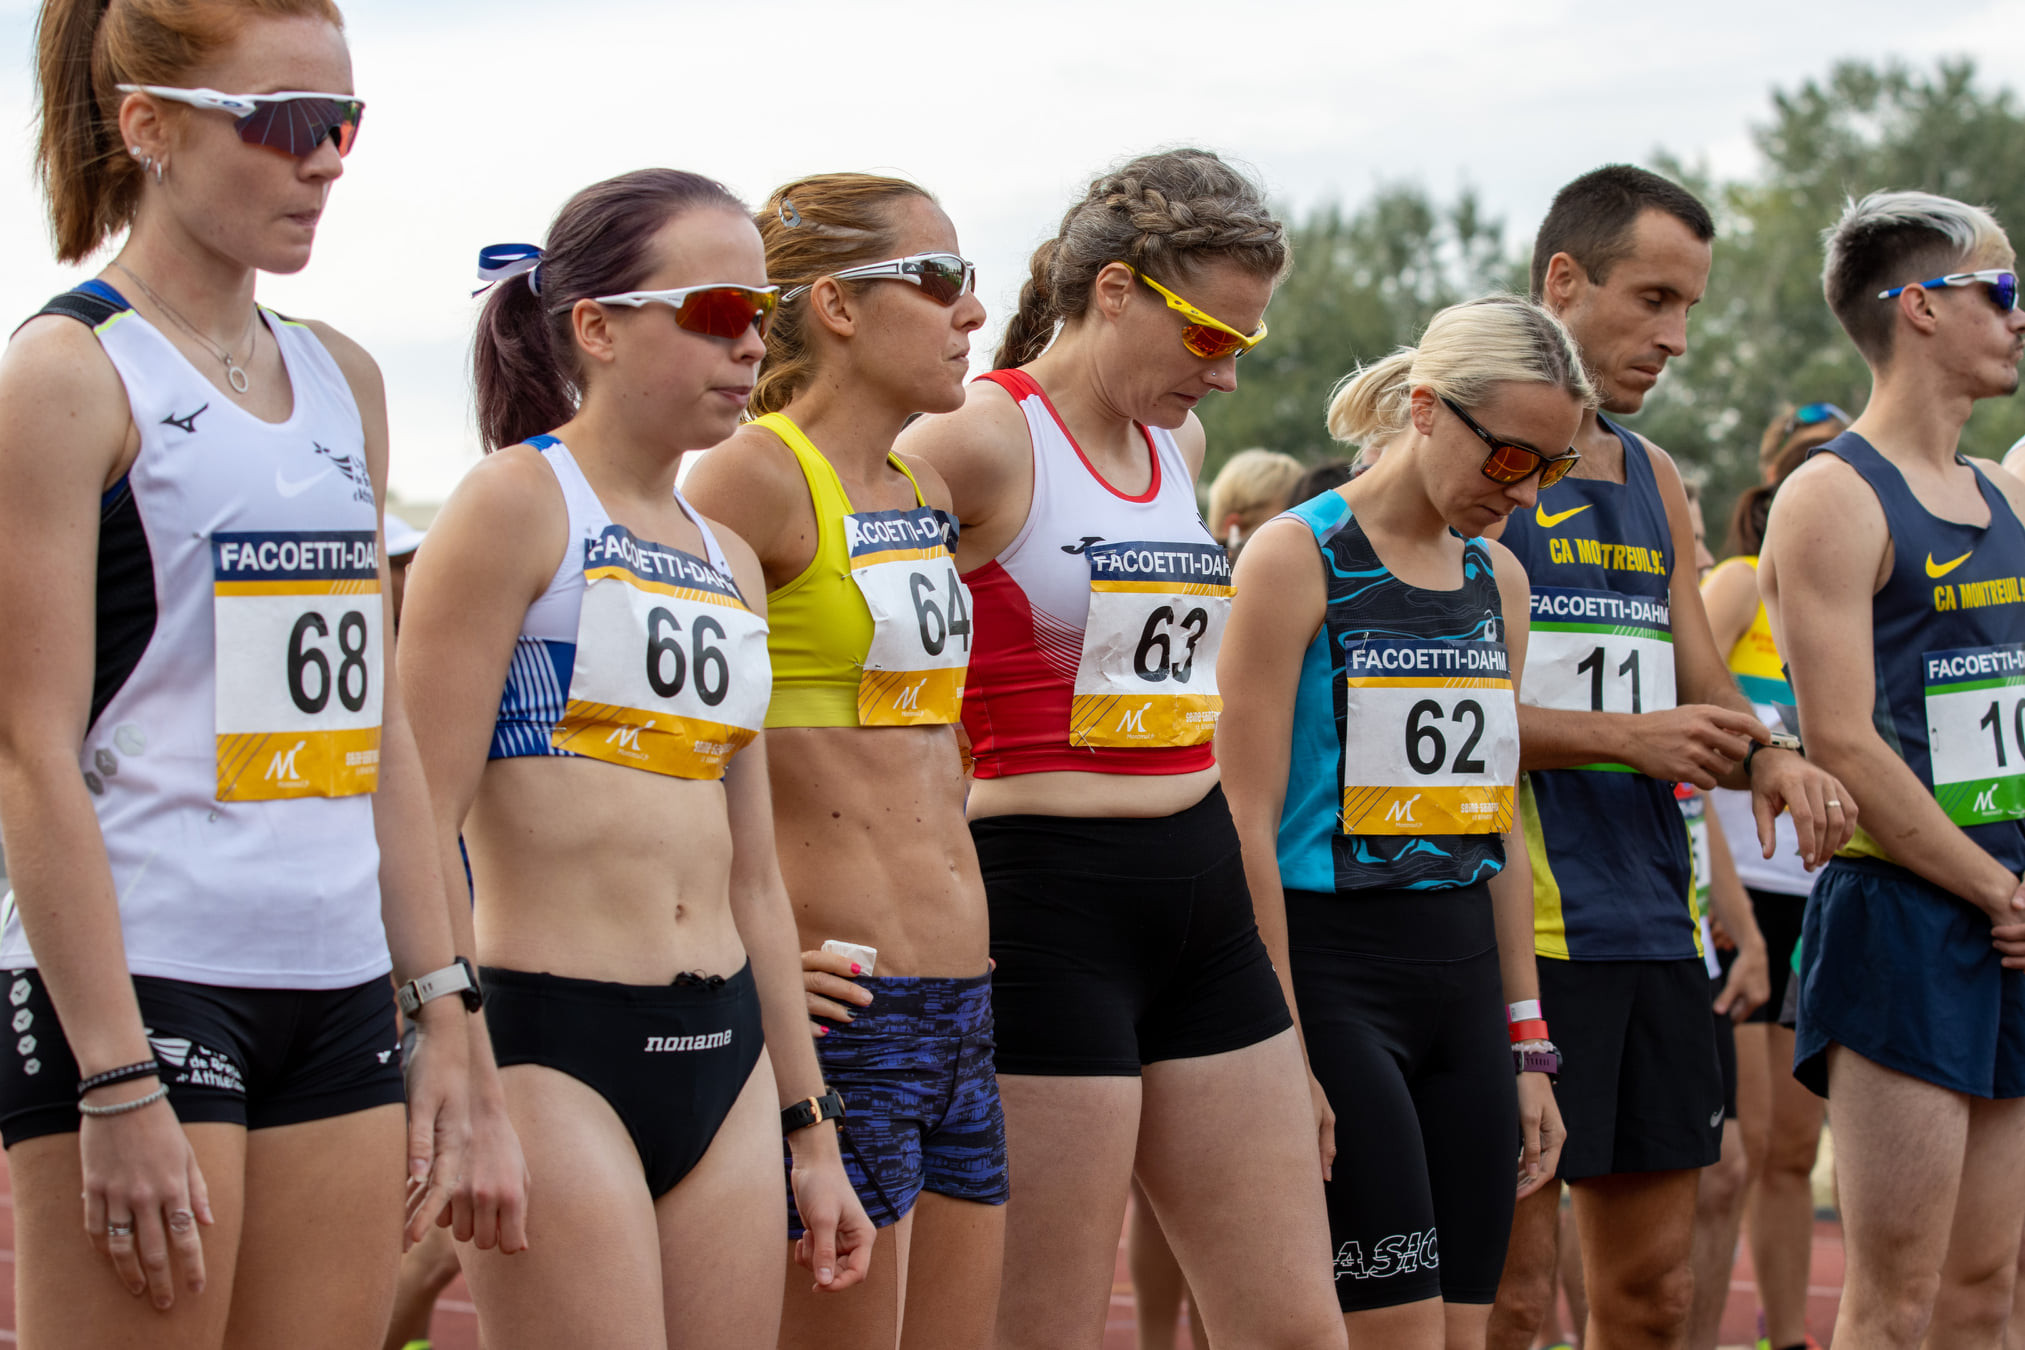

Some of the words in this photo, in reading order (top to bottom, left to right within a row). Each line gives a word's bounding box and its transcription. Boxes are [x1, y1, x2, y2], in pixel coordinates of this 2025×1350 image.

[1549, 538, 1575, 564] CA
[909, 567, 970, 657] 64
[1530, 594, 1670, 626] FACOETTI-DAHM
[1934, 585, 1957, 611] CA
[1958, 577, 2021, 609] MONTREUIL
[287, 611, 368, 715] 68
[646, 606, 729, 707] 66
[1133, 605, 1208, 684] 63
[1352, 648, 1507, 672] FACOETTI-DAHM
[1577, 646, 1642, 714] 11
[1405, 699, 1485, 776] 62
[644, 1029, 732, 1052] noname
